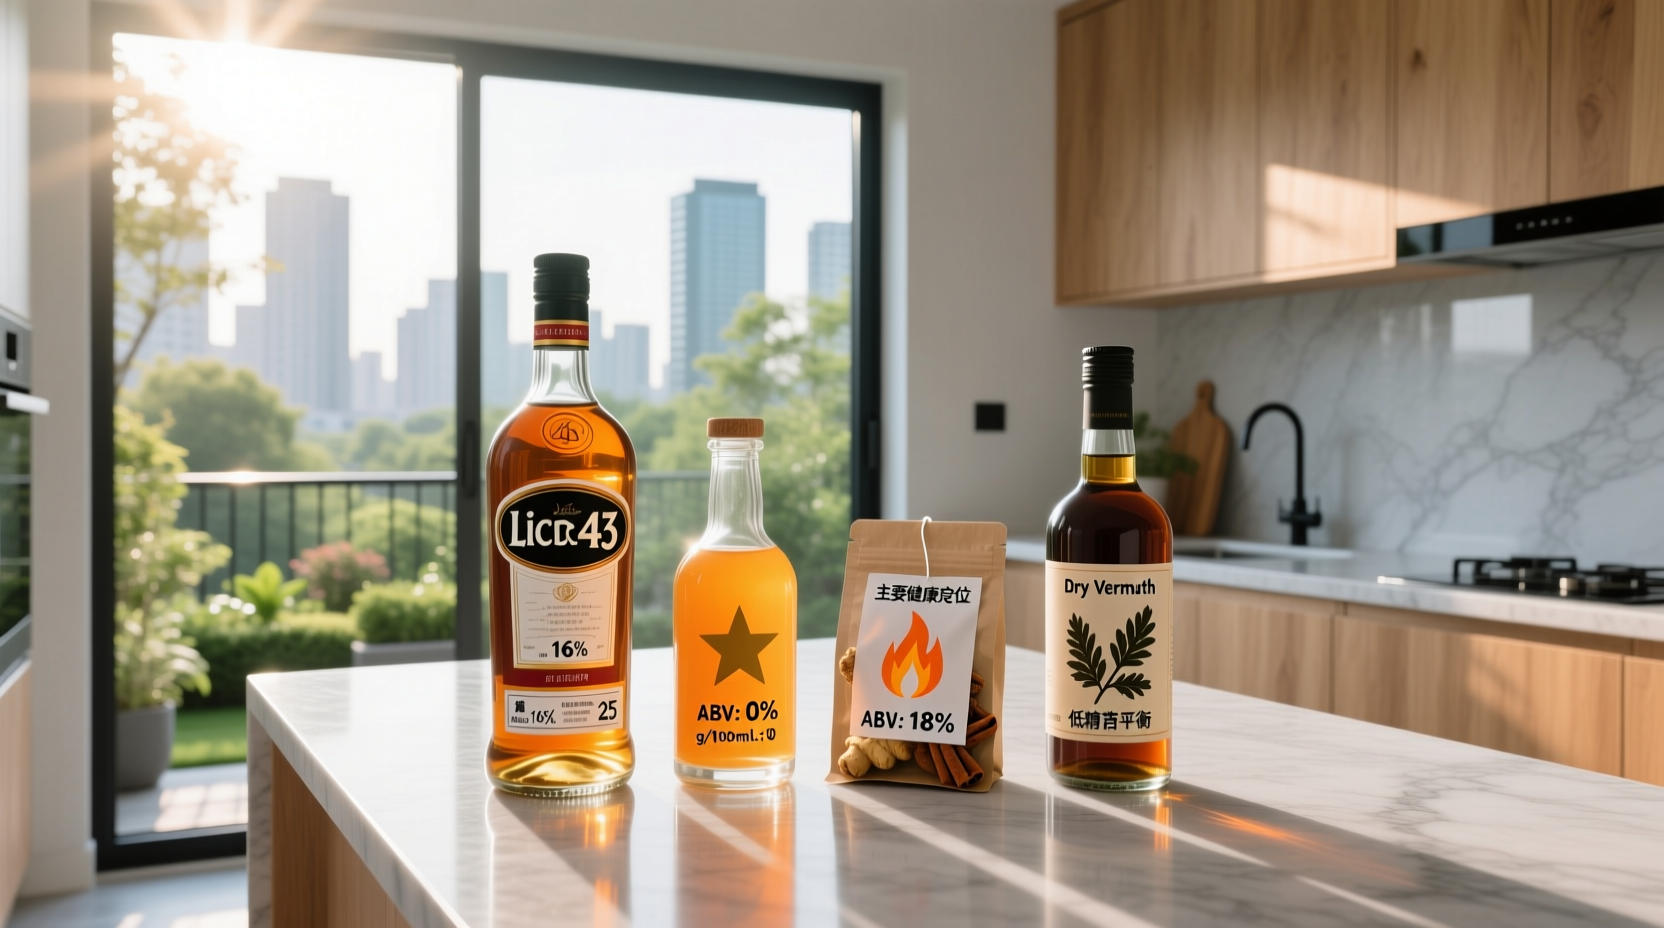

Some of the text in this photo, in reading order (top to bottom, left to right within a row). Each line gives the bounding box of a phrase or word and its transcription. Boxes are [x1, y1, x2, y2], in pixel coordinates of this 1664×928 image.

[1064, 578, 1090, 599] Dry
[551, 640, 588, 658] 16%
[598, 700, 618, 721] 25
[697, 700, 778, 722] ABV: 0%
[861, 710, 955, 733] ABV: 18%
